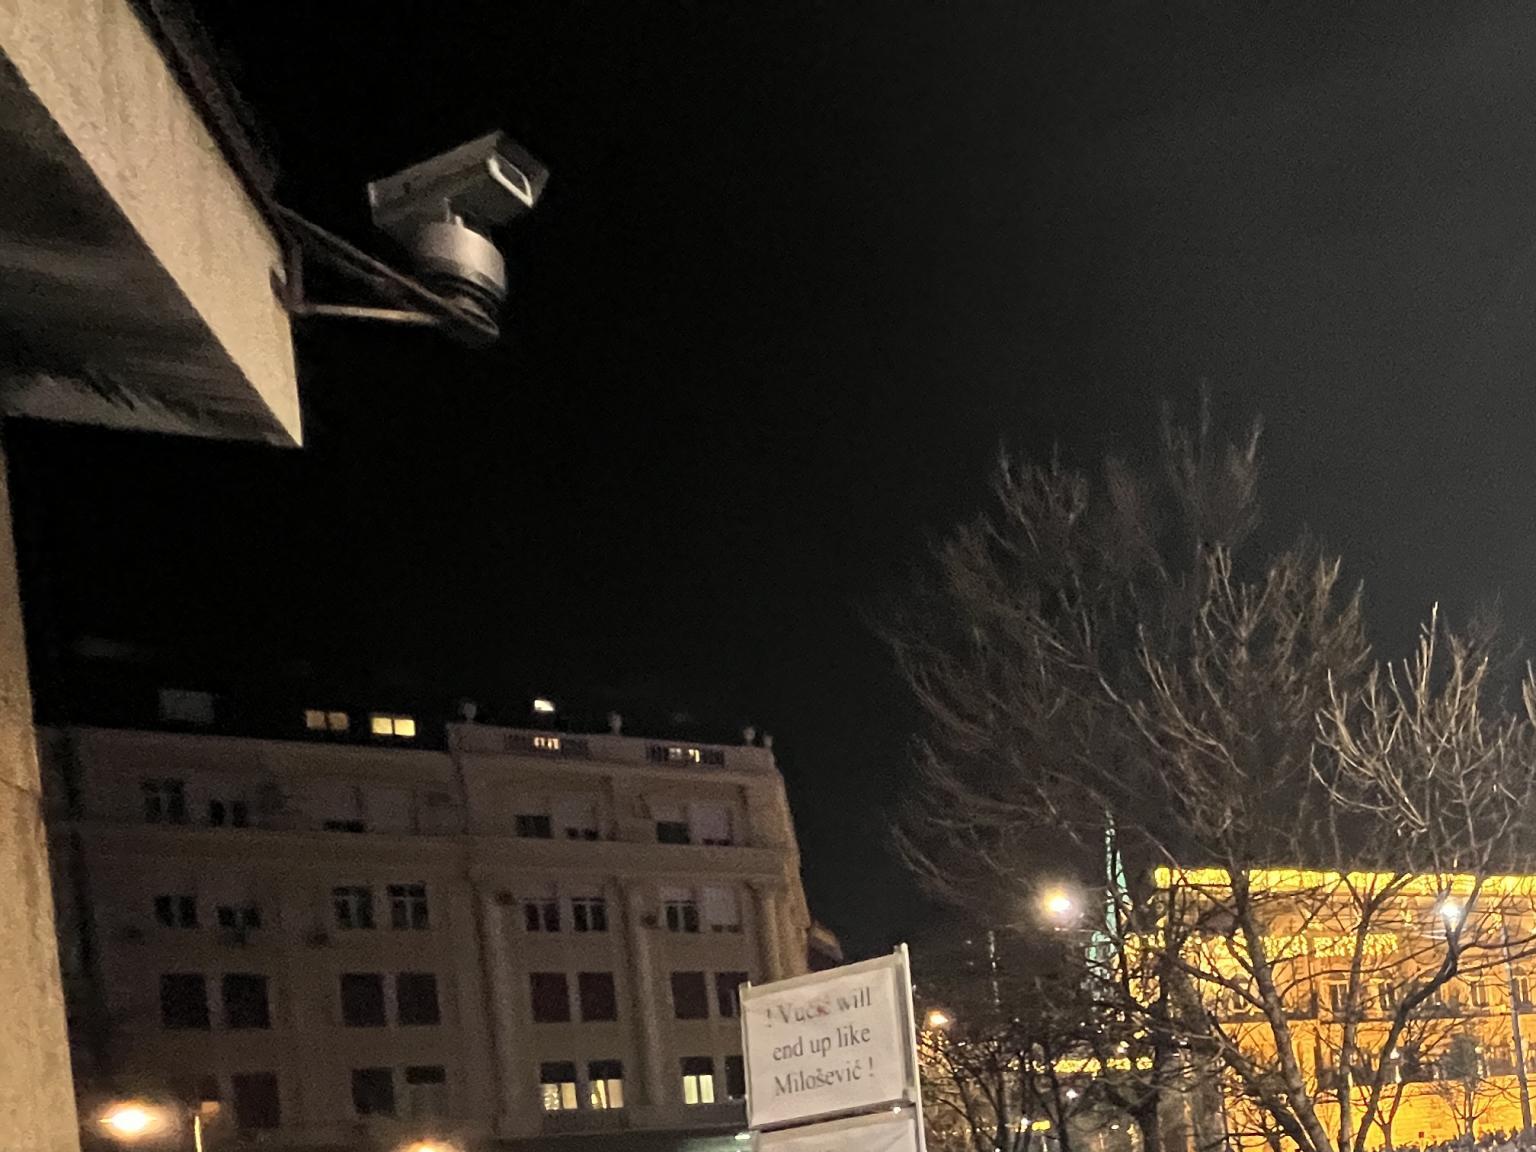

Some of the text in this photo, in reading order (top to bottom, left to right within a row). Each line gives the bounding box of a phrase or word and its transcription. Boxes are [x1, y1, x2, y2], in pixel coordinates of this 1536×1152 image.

[836, 986, 872, 1011] will
[772, 1024, 871, 1061] end up like
[773, 1059, 863, 1097] Milošević
